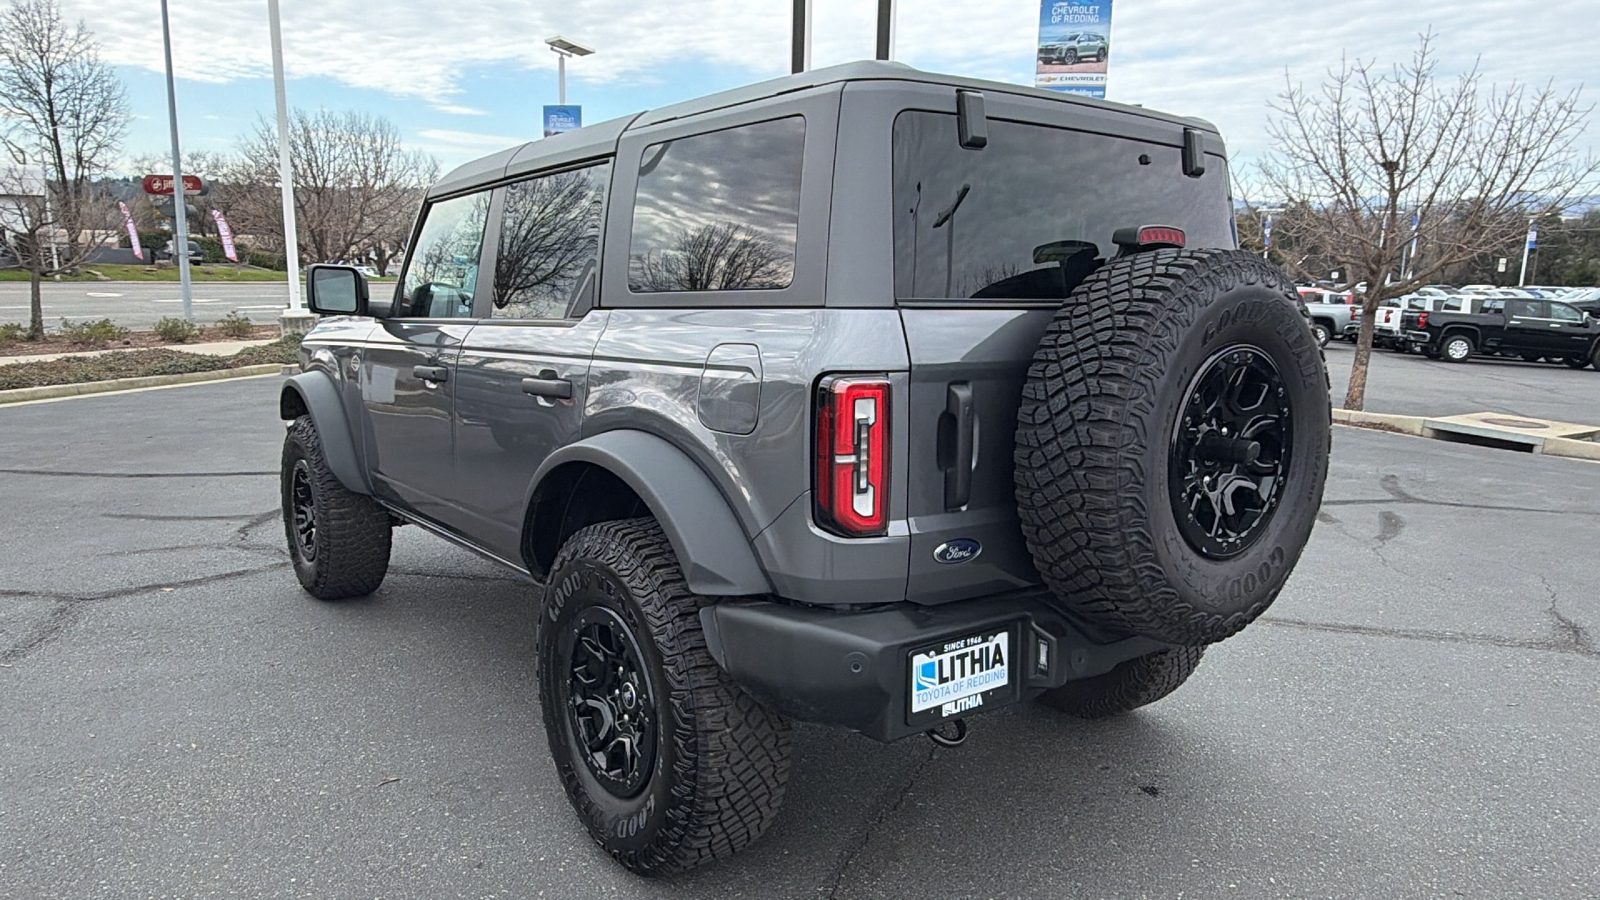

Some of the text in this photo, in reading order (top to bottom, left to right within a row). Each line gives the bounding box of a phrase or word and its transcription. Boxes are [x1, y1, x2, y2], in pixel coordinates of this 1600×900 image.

[1051, 5, 1100, 15] CHEVROLET
[1051, 14, 1099, 24] OF REDDING
[946, 546, 972, 560] Ford
[943, 639, 966, 653] SINCE
[938, 642, 1005, 686] LITHIA
[916, 668, 1006, 705] TOYOTA OF REDDING
[951, 693, 984, 714] LITHIA
